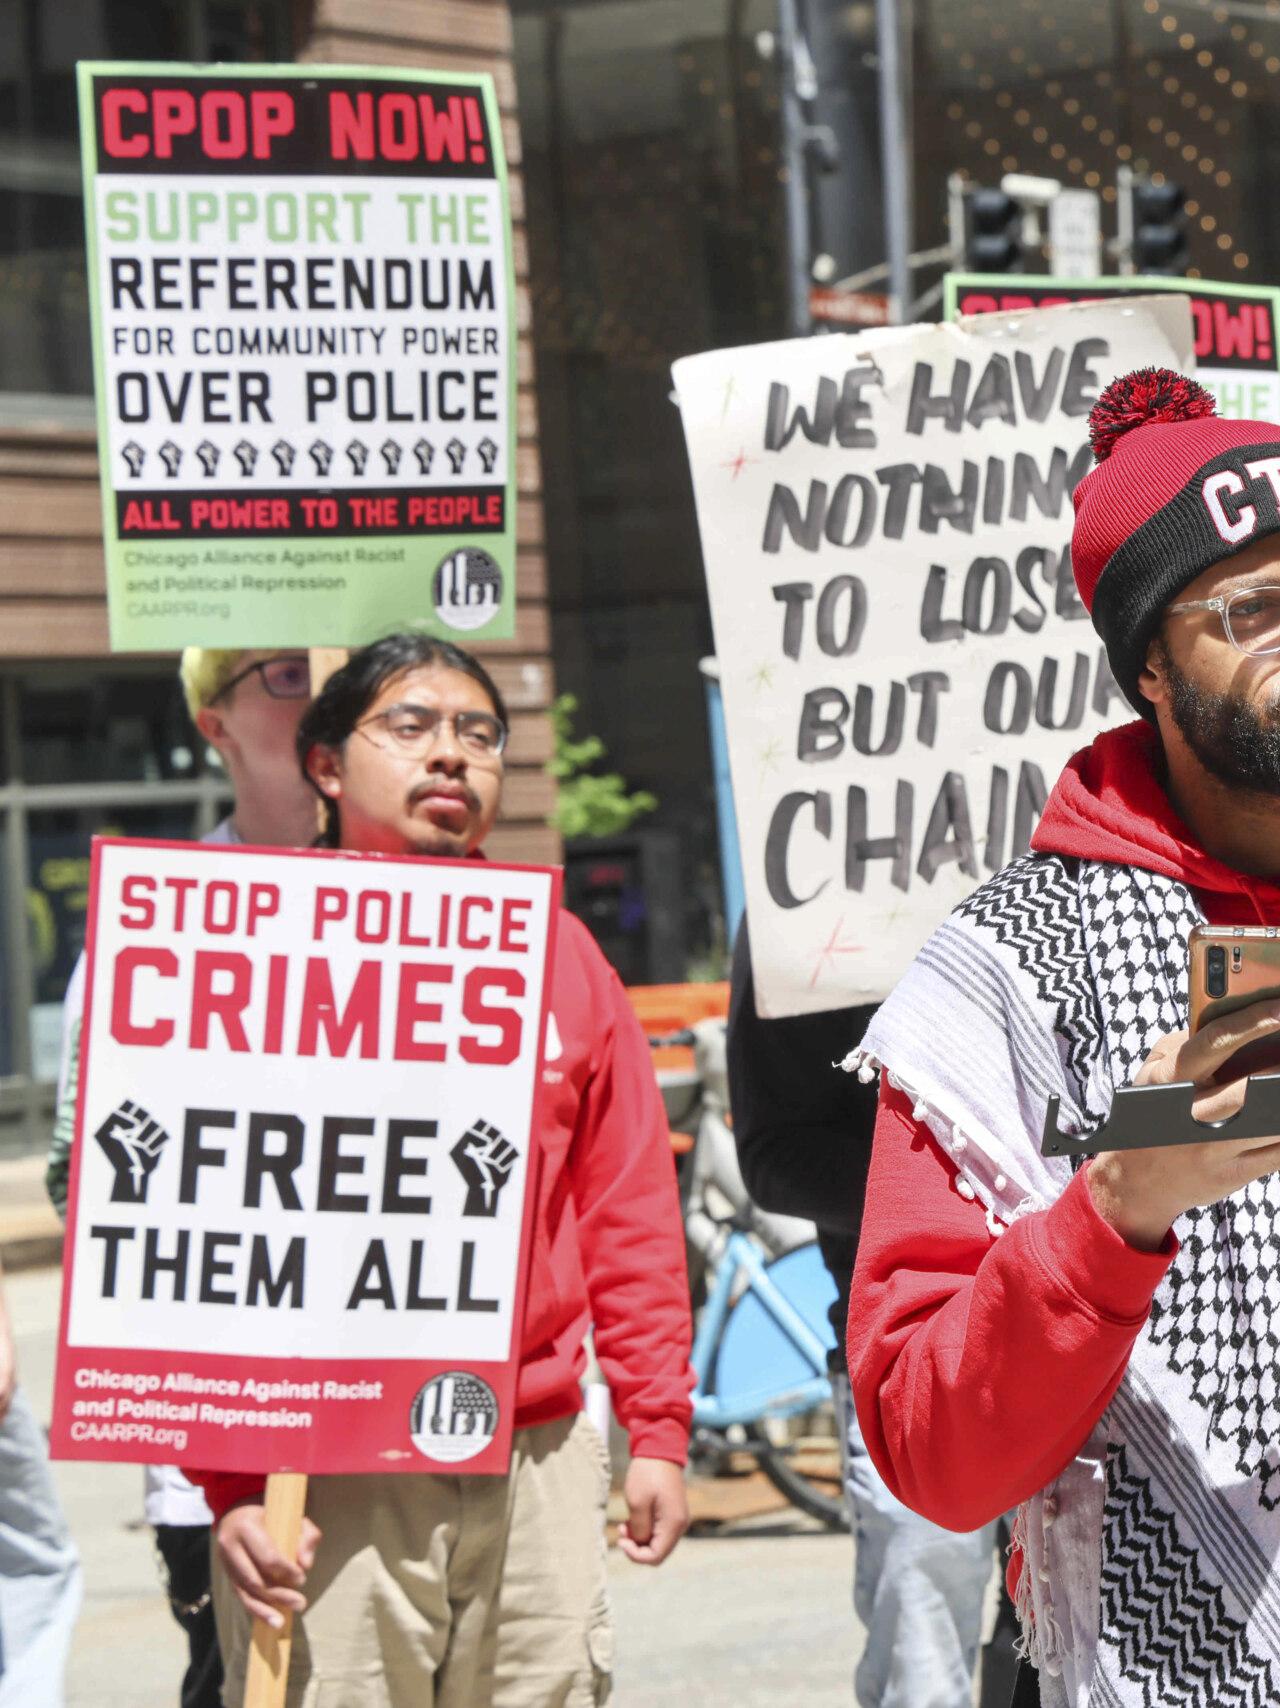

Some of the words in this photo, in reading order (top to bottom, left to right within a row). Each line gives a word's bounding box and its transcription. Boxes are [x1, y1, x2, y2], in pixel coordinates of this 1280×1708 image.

[101, 88, 295, 159] CPOP
[330, 92, 486, 163] NOW!
[106, 190, 372, 244] SUPPORT
[397, 194, 492, 245] THE
[109, 257, 496, 311] REFERENDUM
[114, 327, 176, 356] FOR
[193, 327, 386, 356] COMMUNITY
[403, 327, 499, 355] POWER
[1190, 299, 1272, 360] OW!
[116, 371, 274, 424] OVER
[306, 370, 498, 423] POLICE
[764, 366, 884, 450] WE
[906, 338, 1109, 436] HAVE
[1202, 382, 1270, 420] HE
[122, 499, 181, 531] ALL
[191, 499, 290, 530] POWER
[301, 499, 338, 529] TO
[348, 497, 399, 528] THE
[407, 495, 501, 526] PEOPLE
[124, 549, 200, 571] Chicago
[200, 549, 277, 566] Alliance
[281, 548, 352, 569] Against
[355, 547, 406, 564] Racist
[773, 575, 868, 662] TO
[798, 671, 950, 763] BUT
[119, 875, 280, 937] STOP
[313, 886, 534, 953] POLICE
[110, 945, 527, 1066] CRIMES
[178, 1107, 439, 1215] FREE
[90, 1225, 306, 1310] THEM
[345, 1238, 501, 1313] ALL
[74, 1368, 160, 1394] Chicago
[162, 1373, 241, 1396] Alliance
[242, 1378, 320, 1402] Against
[323, 1380, 383, 1400] Racist
[70, 1421, 188, 1450] CAARPR.org
[72, 1398, 114, 1418] and
[117, 1399, 198, 1423] Political
[200, 1405, 312, 1429] Repression
